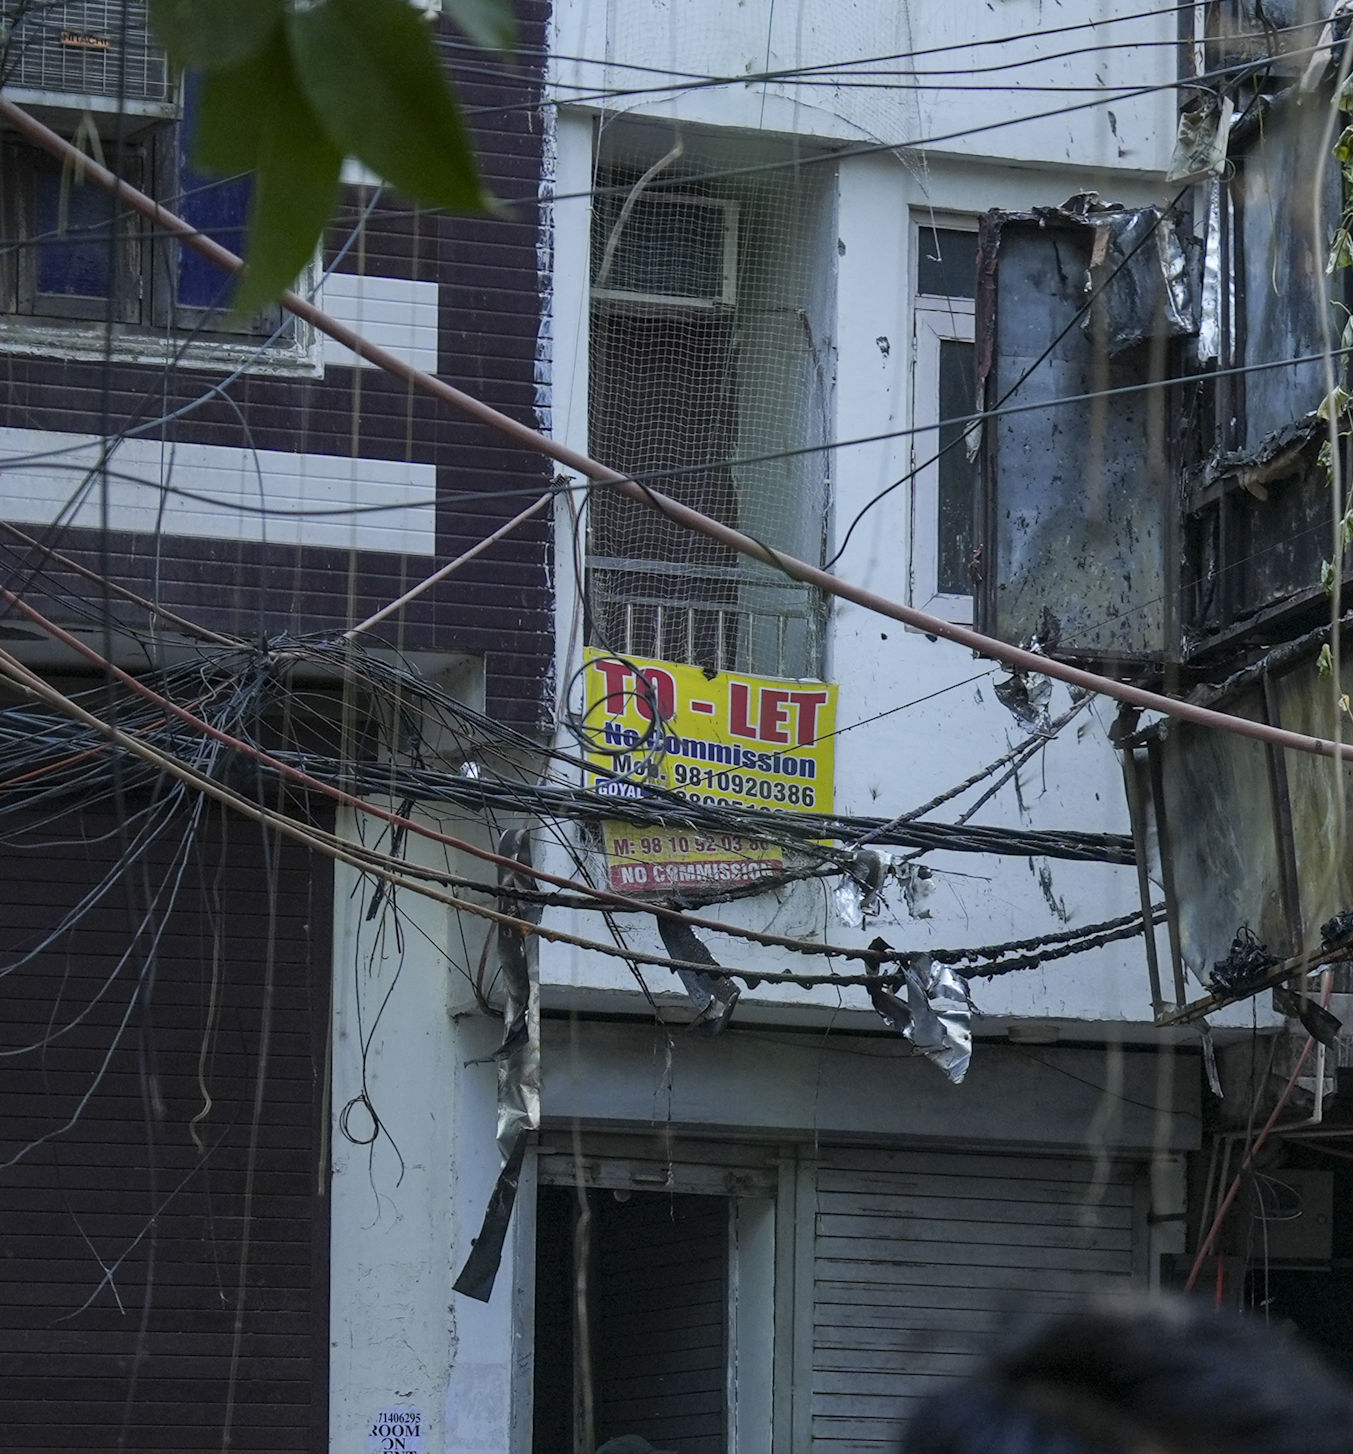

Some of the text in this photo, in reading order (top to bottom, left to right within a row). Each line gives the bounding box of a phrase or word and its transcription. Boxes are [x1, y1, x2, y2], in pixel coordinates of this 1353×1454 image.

[594, 658, 676, 722] TO
[729, 681, 828, 748] LET
[604, 721, 817, 779] No Commission
[598, 782, 644, 799] GOYAL
[674, 763, 816, 808] 9810920386
[613, 838, 635, 856] M:
[640, 837, 663, 854] 98
[669, 836, 690, 853] 10
[620, 862, 774, 885] NO COMMISSION
